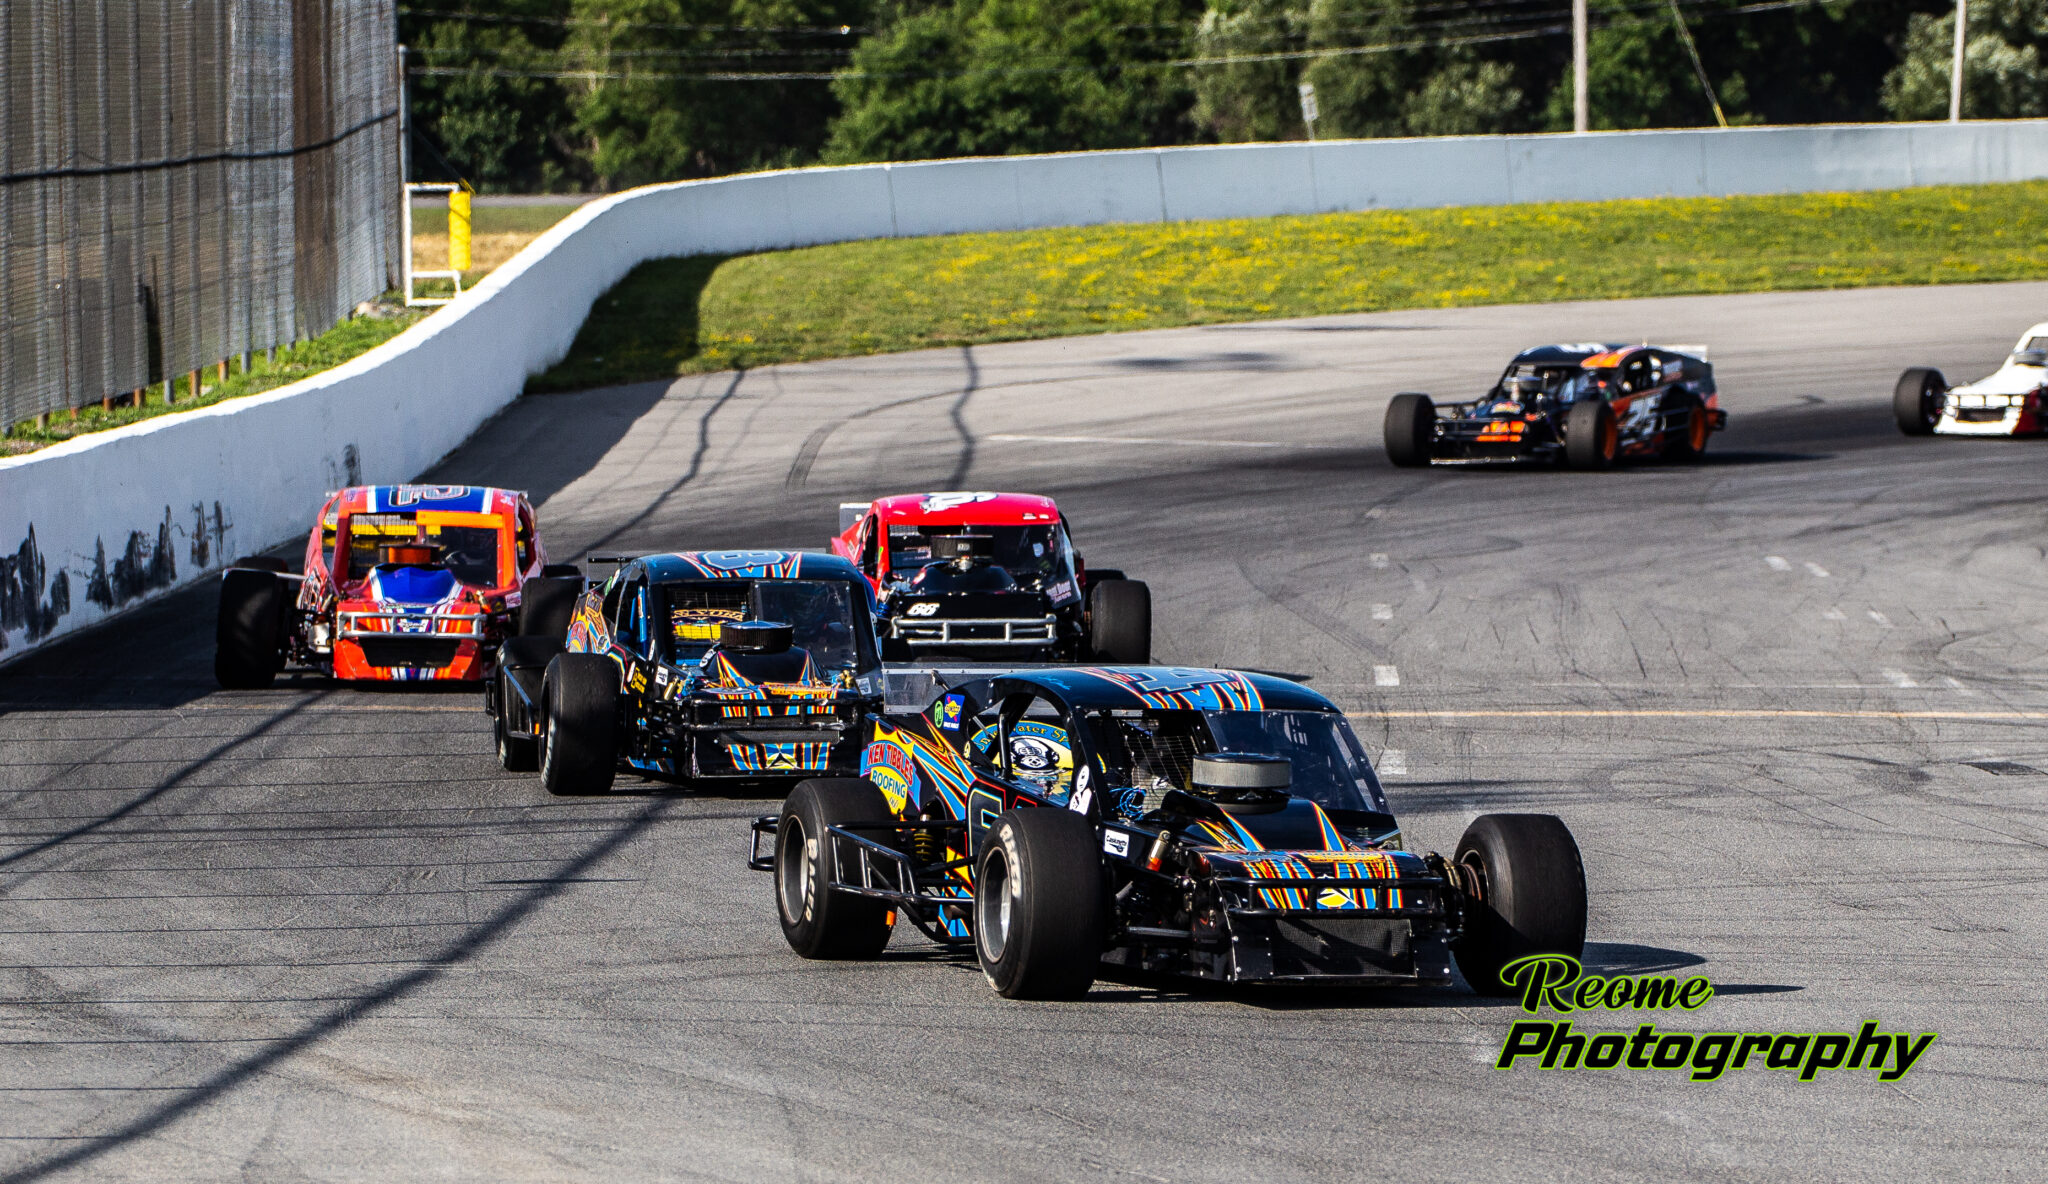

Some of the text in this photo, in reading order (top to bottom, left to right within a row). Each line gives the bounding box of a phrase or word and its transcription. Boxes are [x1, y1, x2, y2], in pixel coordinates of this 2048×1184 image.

[907, 602, 941, 616] 66
[867, 743, 914, 787] KEN TIBBLES
[871, 769, 906, 799] ROOFING
[805, 838, 819, 922] RACER
